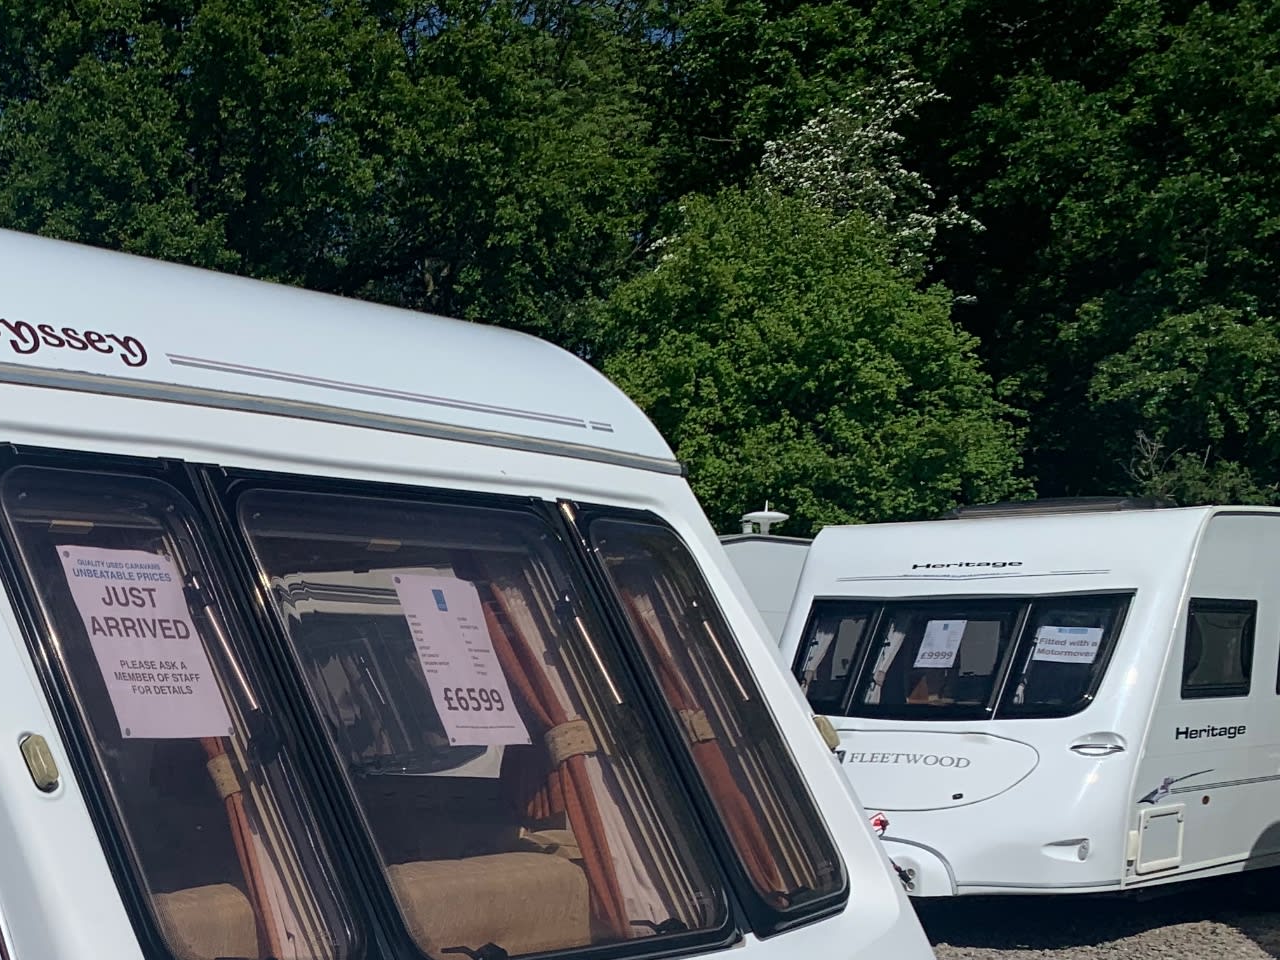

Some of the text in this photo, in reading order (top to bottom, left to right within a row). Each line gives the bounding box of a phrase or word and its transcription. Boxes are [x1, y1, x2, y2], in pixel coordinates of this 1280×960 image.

[77, 558, 105, 568] QUALITY
[107, 561, 124, 570] USED
[912, 561, 1023, 569] Heritage
[72, 568, 172, 583] UNBEATABLE PRICES
[101, 585, 157, 608] JUST
[91, 615, 191, 640] ARRIVED
[1039, 637, 1067, 646] Fitted
[1069, 639, 1089, 647] with
[920, 651, 954, 660] £9999
[120, 660, 188, 670] PLEASE ASK A
[114, 671, 201, 683] MEMBER OF STAFF
[131, 685, 193, 695] FOR DETAILS
[443, 687, 505, 712] £6599
[1175, 724, 1247, 740] Heritage
[849, 752, 971, 769] FLEETWOOD
